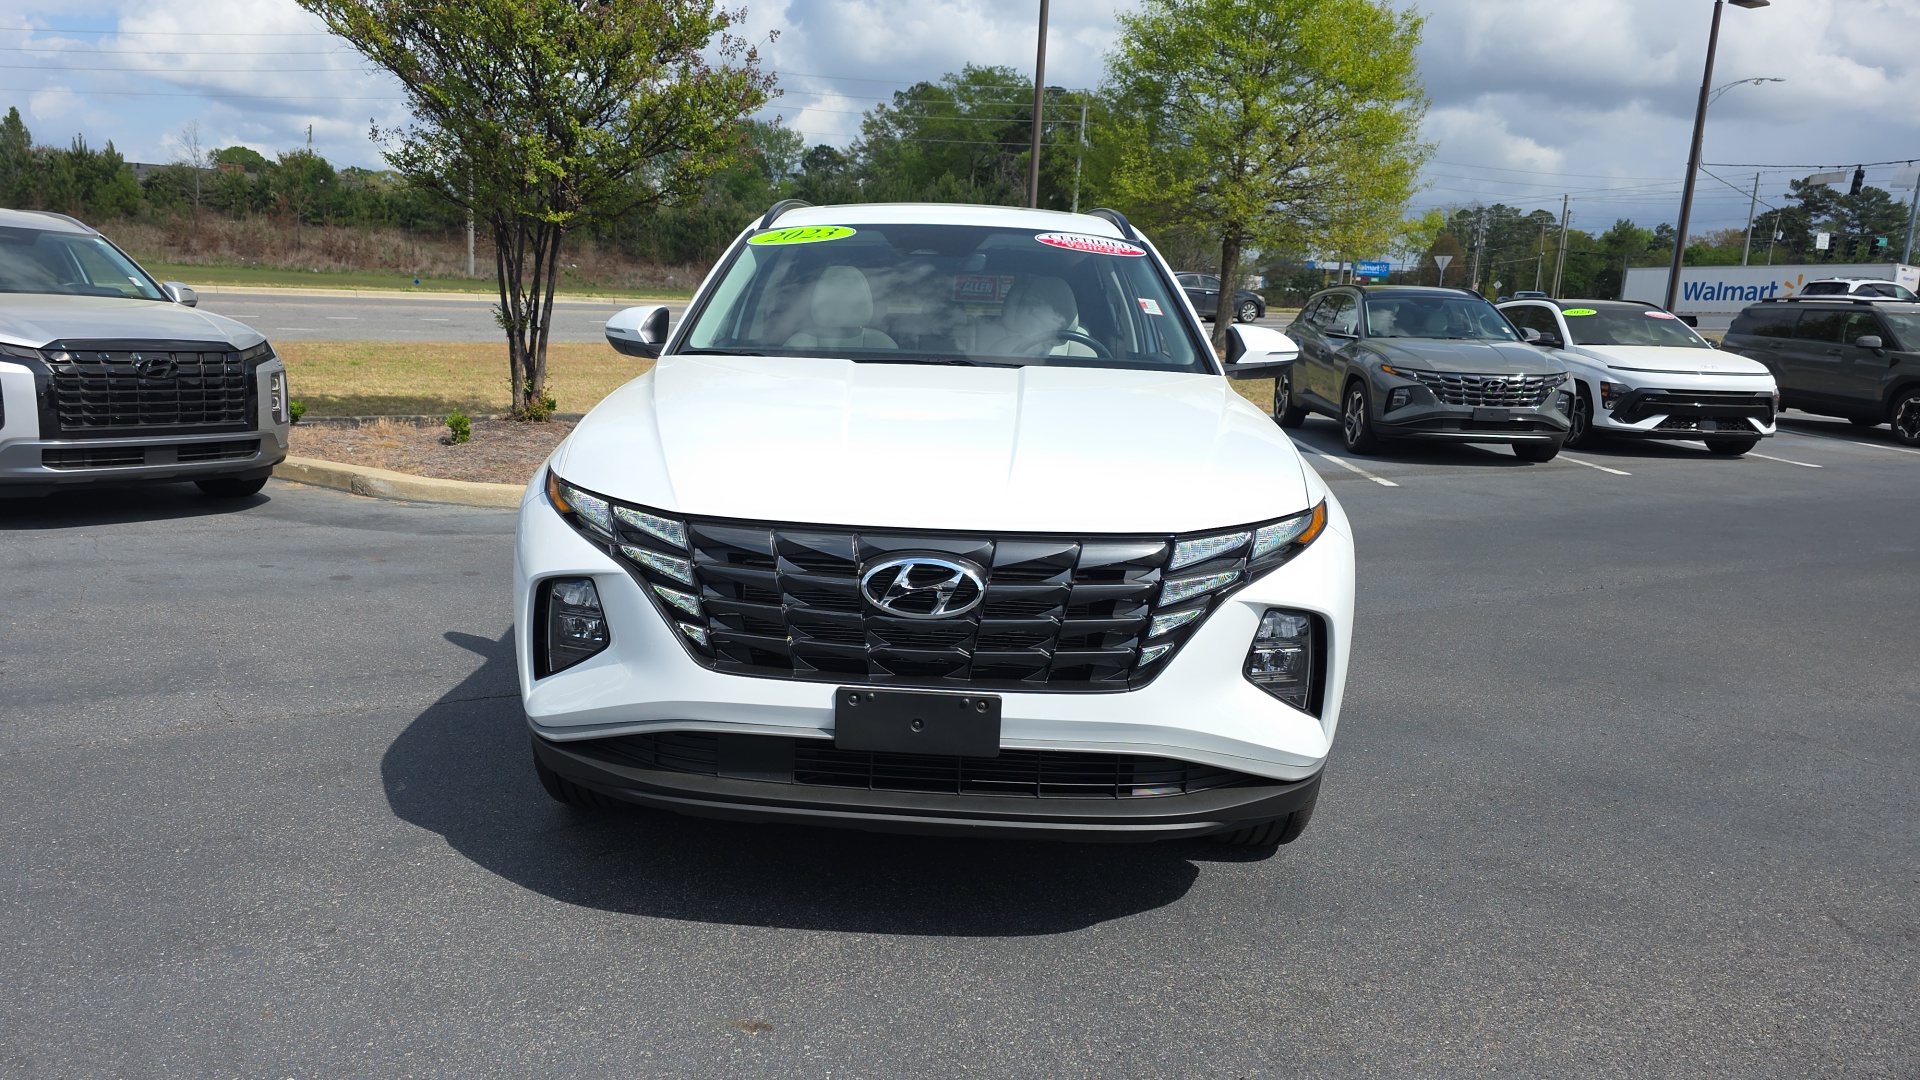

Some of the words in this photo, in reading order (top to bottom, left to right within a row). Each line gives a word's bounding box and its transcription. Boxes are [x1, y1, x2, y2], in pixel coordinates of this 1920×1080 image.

[764, 228, 840, 243] 2023
[1048, 235, 1133, 250] CERTIFIED
[962, 282, 993, 293] ALLEN
[1683, 281, 1778, 301] Walmart
